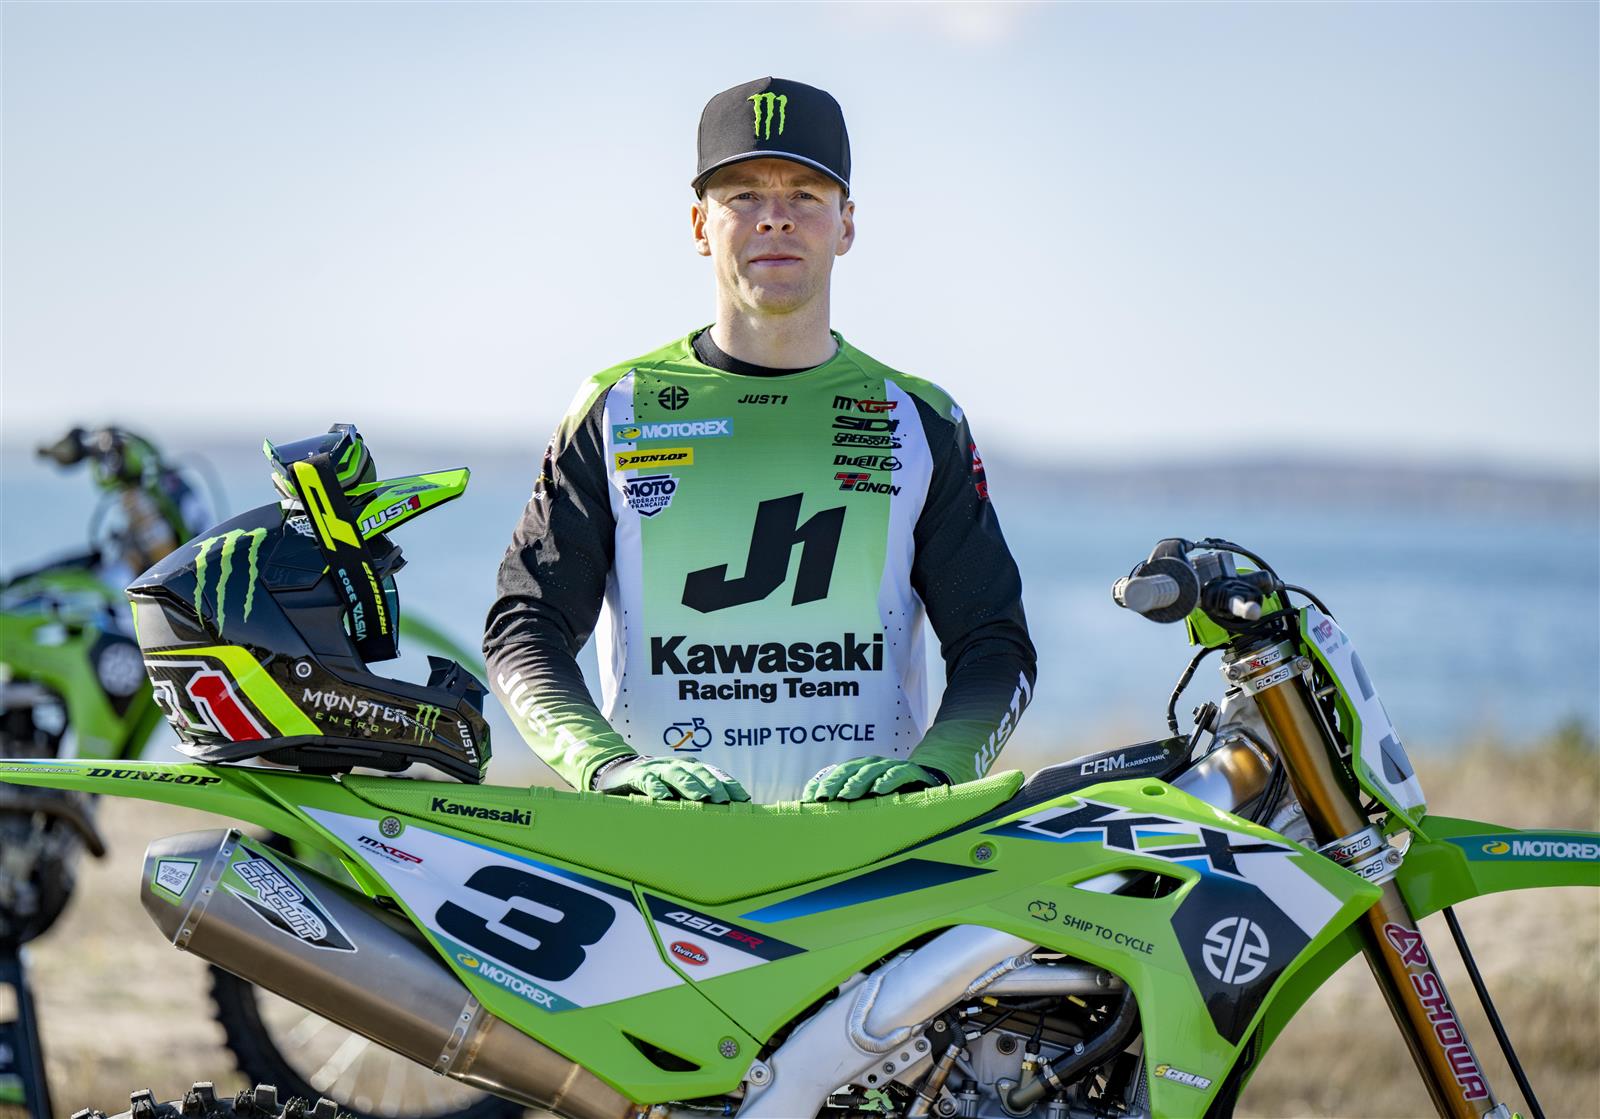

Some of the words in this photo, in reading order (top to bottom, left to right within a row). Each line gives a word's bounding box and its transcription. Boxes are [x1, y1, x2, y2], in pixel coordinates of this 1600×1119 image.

[737, 394, 788, 405] JUST1
[832, 395, 898, 414] MXGP
[642, 420, 729, 439] MOTOREX
[629, 453, 688, 464] DUNLOP
[623, 479, 676, 499] MOTO
[834, 472, 901, 496] TONON
[361, 561, 388, 636] PROGRIP
[353, 601, 367, 642] VISTA
[650, 633, 884, 676] Kawasaki
[678, 679, 777, 704] Racing
[783, 677, 860, 699] Team
[315, 711, 393, 735] ENERGY
[724, 728, 772, 747] SHIP
[776, 727, 807, 744] TO
[811, 724, 875, 743] CYCLE
[456, 720, 478, 765] JUST1
[86, 768, 222, 786] DUNLOP
[431, 797, 532, 826] Kawasaki
[357, 835, 424, 864] MXGP
[435, 865, 616, 981] 3
[1062, 914, 1093, 931] SHIP
[1096, 926, 1113, 940] TO
[1115, 934, 1155, 955] CYCLE
[673, 945, 692, 959] Twin
[479, 961, 554, 1008] MOTOREX
[1409, 972, 1489, 1101] SHOWA
